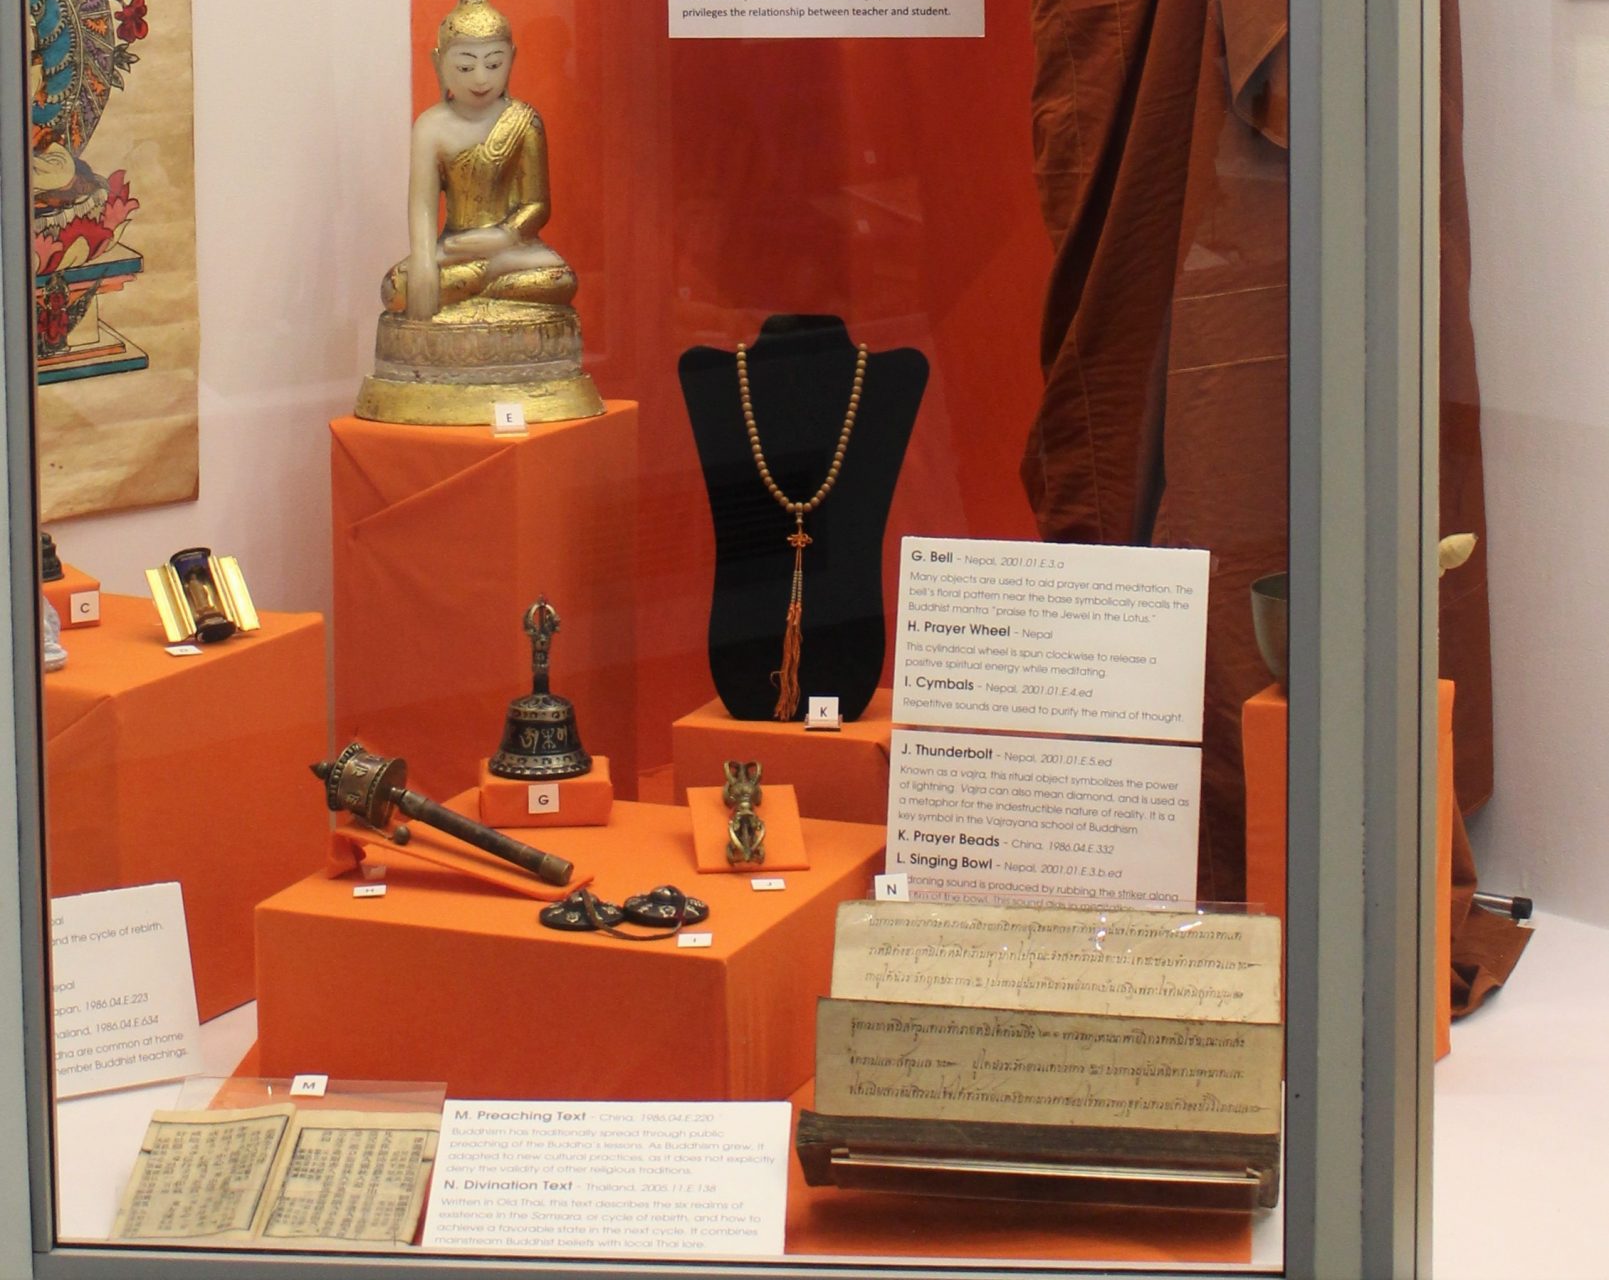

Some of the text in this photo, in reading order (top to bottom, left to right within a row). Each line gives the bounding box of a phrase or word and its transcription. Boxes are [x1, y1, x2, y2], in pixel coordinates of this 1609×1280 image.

[682, 6, 951, 18] privileges the relationship between teacher and student.
[506, 413, 513, 423] E
[930, 550, 953, 562] Bell
[80, 602, 90, 614] C
[924, 621, 966, 635] Prayer
[969, 623, 1011, 636] Wheel
[1022, 628, 1053, 640] Nepal
[915, 676, 974, 690] Cymbals
[820, 706, 828, 718] K
[903, 696, 953, 708] Repetitive
[954, 701, 990, 711] sounds
[991, 703, 1009, 712] are
[1011, 705, 1036, 713] used
[1038, 705, 1049, 714] to
[1050, 706, 1079, 717] purify
[1081, 707, 1098, 717] the
[1100, 709, 1126, 719] mind
[1128, 710, 1140, 719] of
[915, 743, 993, 759] Thunderbolt
[538, 794, 549, 806] G
[913, 830, 956, 845] Prayer
[959, 833, 1000, 847] Beads
[910, 852, 958, 870] Singing
[961, 856, 993, 869] Bowl
[887, 883, 898, 895] N
[71, 933, 87, 943] the
[89, 929, 116, 942] cycle
[119, 926, 129, 936] of
[54, 1006, 81, 1018] apan,
[77, 1048, 94, 1057] are
[96, 1040, 141, 1054] common
[143, 1037, 153, 1046] at
[155, 1032, 184, 1043] home
[95, 1054, 137, 1070] Buddhist
[302, 1081, 316, 1090] M
